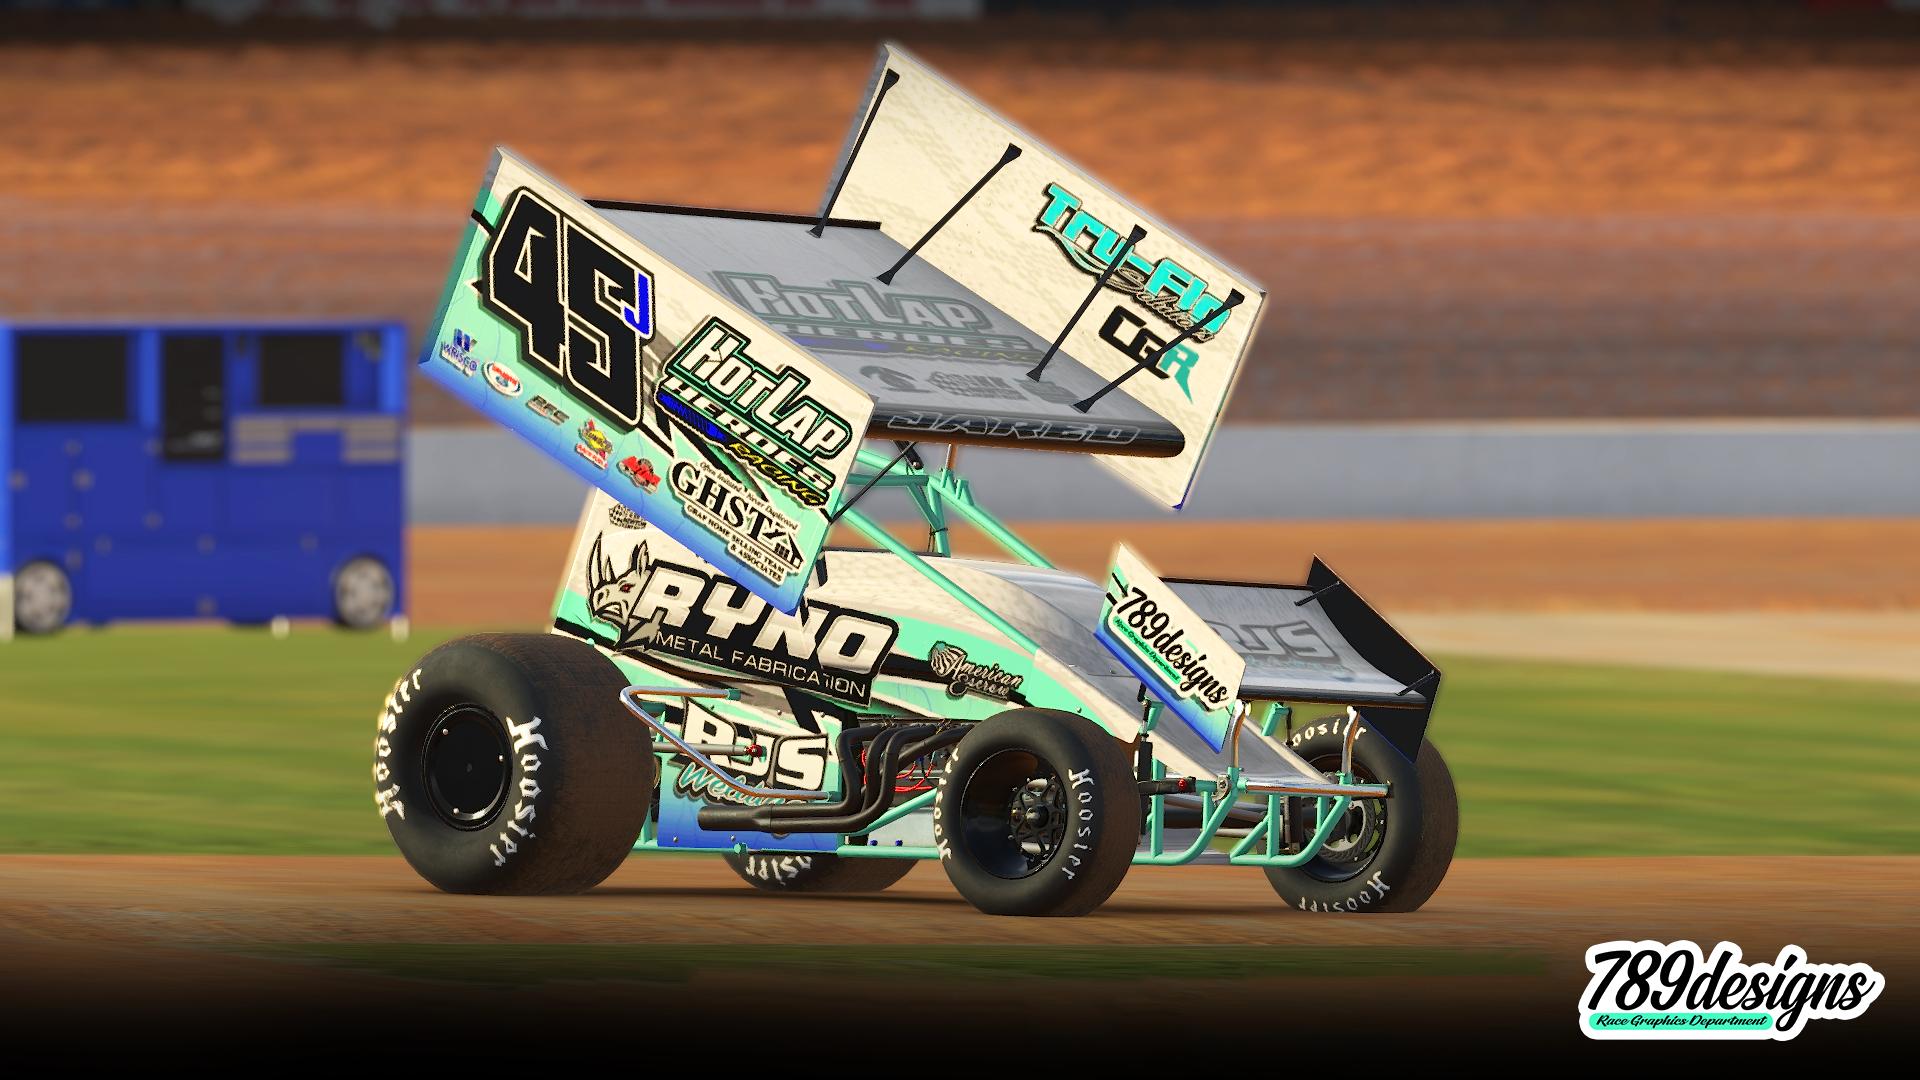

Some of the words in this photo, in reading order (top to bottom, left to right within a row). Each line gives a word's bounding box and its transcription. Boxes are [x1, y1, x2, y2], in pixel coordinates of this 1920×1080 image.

[663, 376, 834, 491] HEROES
[887, 411, 1141, 445] JARED
[672, 461, 774, 540] GHST
[632, 570, 895, 675] RYNO
[655, 631, 723, 662] METAL
[732, 651, 866, 698] FABRICATION
[1117, 586, 1230, 704] 789designs
[938, 655, 1023, 688] American
[1292, 718, 1368, 748] oosir
[506, 716, 550, 867] Hoosier
[1061, 768, 1095, 881] Hoosier
